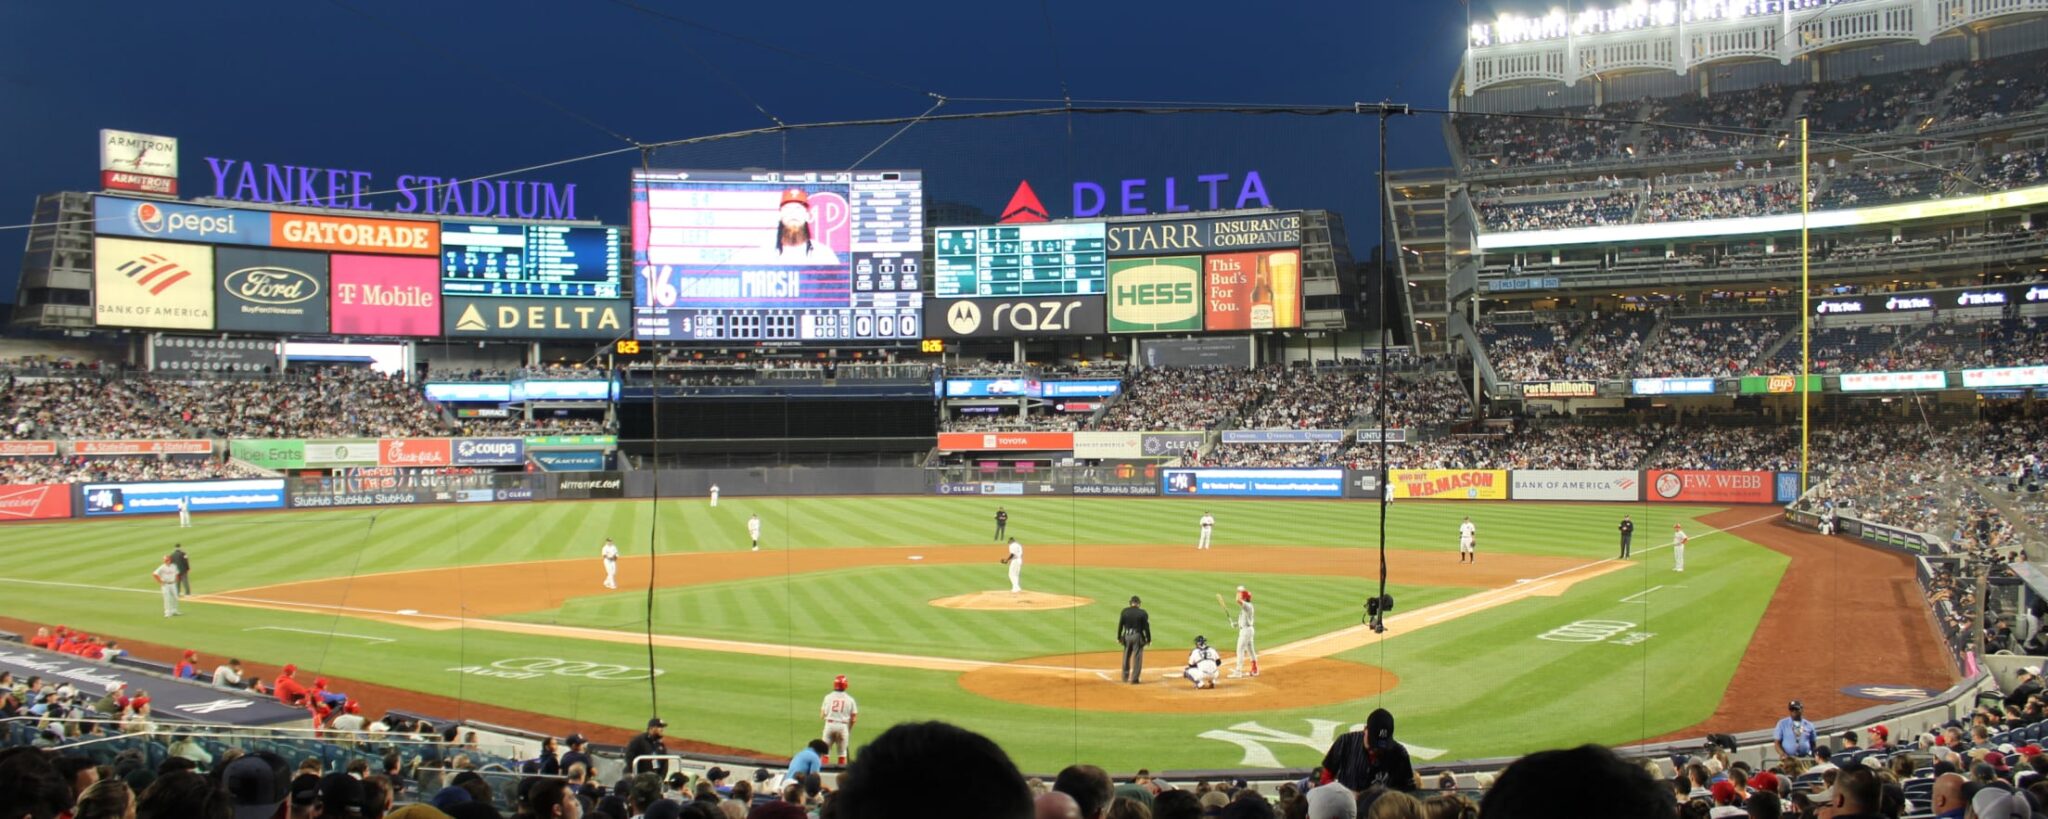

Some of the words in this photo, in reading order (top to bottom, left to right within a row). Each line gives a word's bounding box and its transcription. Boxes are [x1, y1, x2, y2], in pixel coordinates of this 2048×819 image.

[108, 136, 173, 152] ARMITRON
[112, 174, 170, 187] ARMITRON
[204, 156, 372, 211] YANKEE
[395, 174, 577, 220] STADIUM
[1073, 171, 1271, 217] DELTA
[168, 213, 236, 236] pepsi
[1214, 217, 1300, 235] INSURANCE
[283, 220, 429, 249] GATORADE
[1108, 224, 1203, 252] STARR
[1214, 230, 1300, 247] COMPANIES
[1210, 260, 1241, 272] This
[241, 270, 303, 299] Ford
[742, 270, 800, 298] MARSH
[1211, 272, 1247, 285] Bud's
[641, 265, 677, 307] 16
[1211, 287, 1233, 298] For
[362, 284, 433, 307] Mobile
[1117, 283, 1192, 306] HESS
[1970, 293, 2004, 304] TikTok
[1211, 301, 1240, 312] You.
[1829, 302, 1861, 312] TikTok
[1898, 298, 1930, 309] TikTok
[98, 304, 134, 314] BANK
[136, 306, 151, 315] OF
[155, 308, 209, 318] AMERICA
[498, 306, 620, 330] DELTA
[993, 301, 1082, 331] razr
[1523, 383, 1549, 393] Parts
[1550, 382, 1595, 395] Authority
[476, 443, 516, 457] coupa
[1165, 440, 1200, 449] CLEAR
[269, 448, 302, 460] Eats
[1515, 481, 1543, 489] BANK
[1546, 481, 1559, 489] OF
[1562, 482, 1611, 490] AMERICA
[1683, 474, 1712, 488] F.W.
[1716, 474, 1761, 489] WEBB
[294, 496, 331, 507] StubHub
[333, 495, 372, 505] StubHub
[375, 493, 415, 503] StubHub
[831, 699, 845, 713] 21
